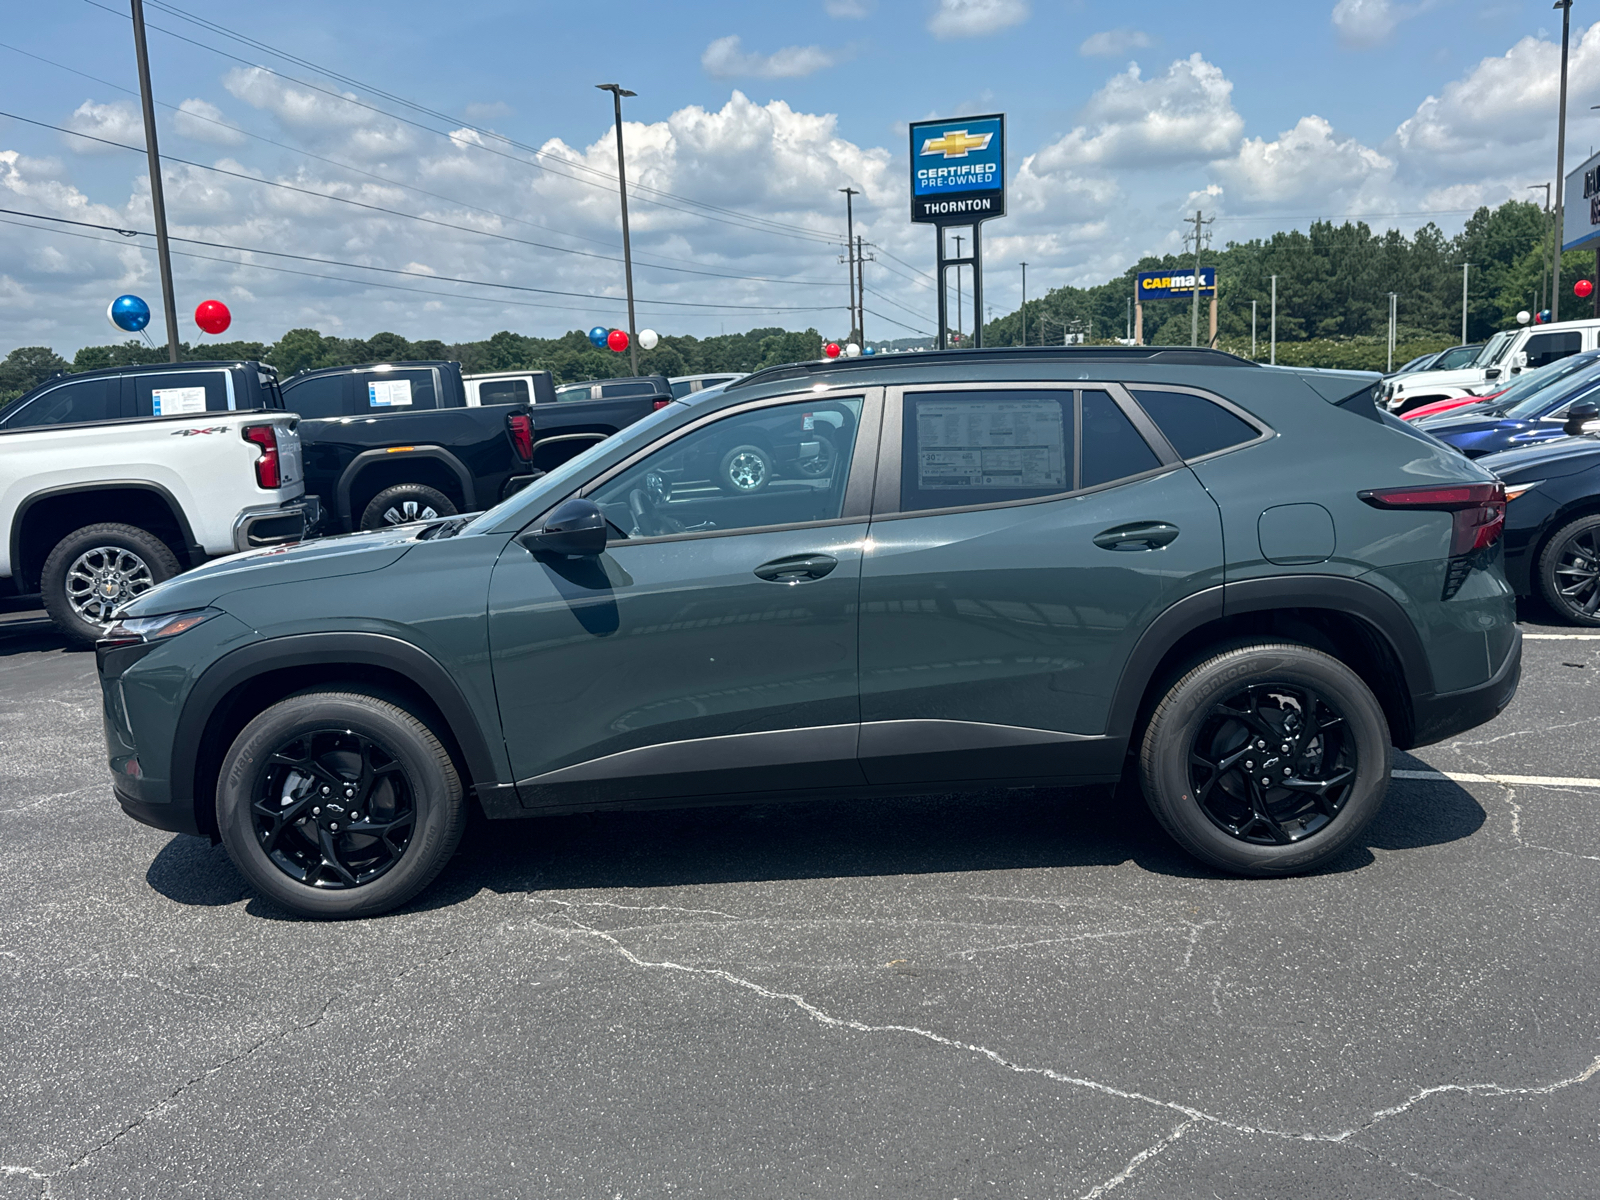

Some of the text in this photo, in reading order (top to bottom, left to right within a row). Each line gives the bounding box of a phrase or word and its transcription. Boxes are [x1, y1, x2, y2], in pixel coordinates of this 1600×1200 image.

[917, 163, 997, 179] CERTIFIED
[921, 173, 993, 188] PRE-OWNED
[924, 198, 991, 215] THORNTON
